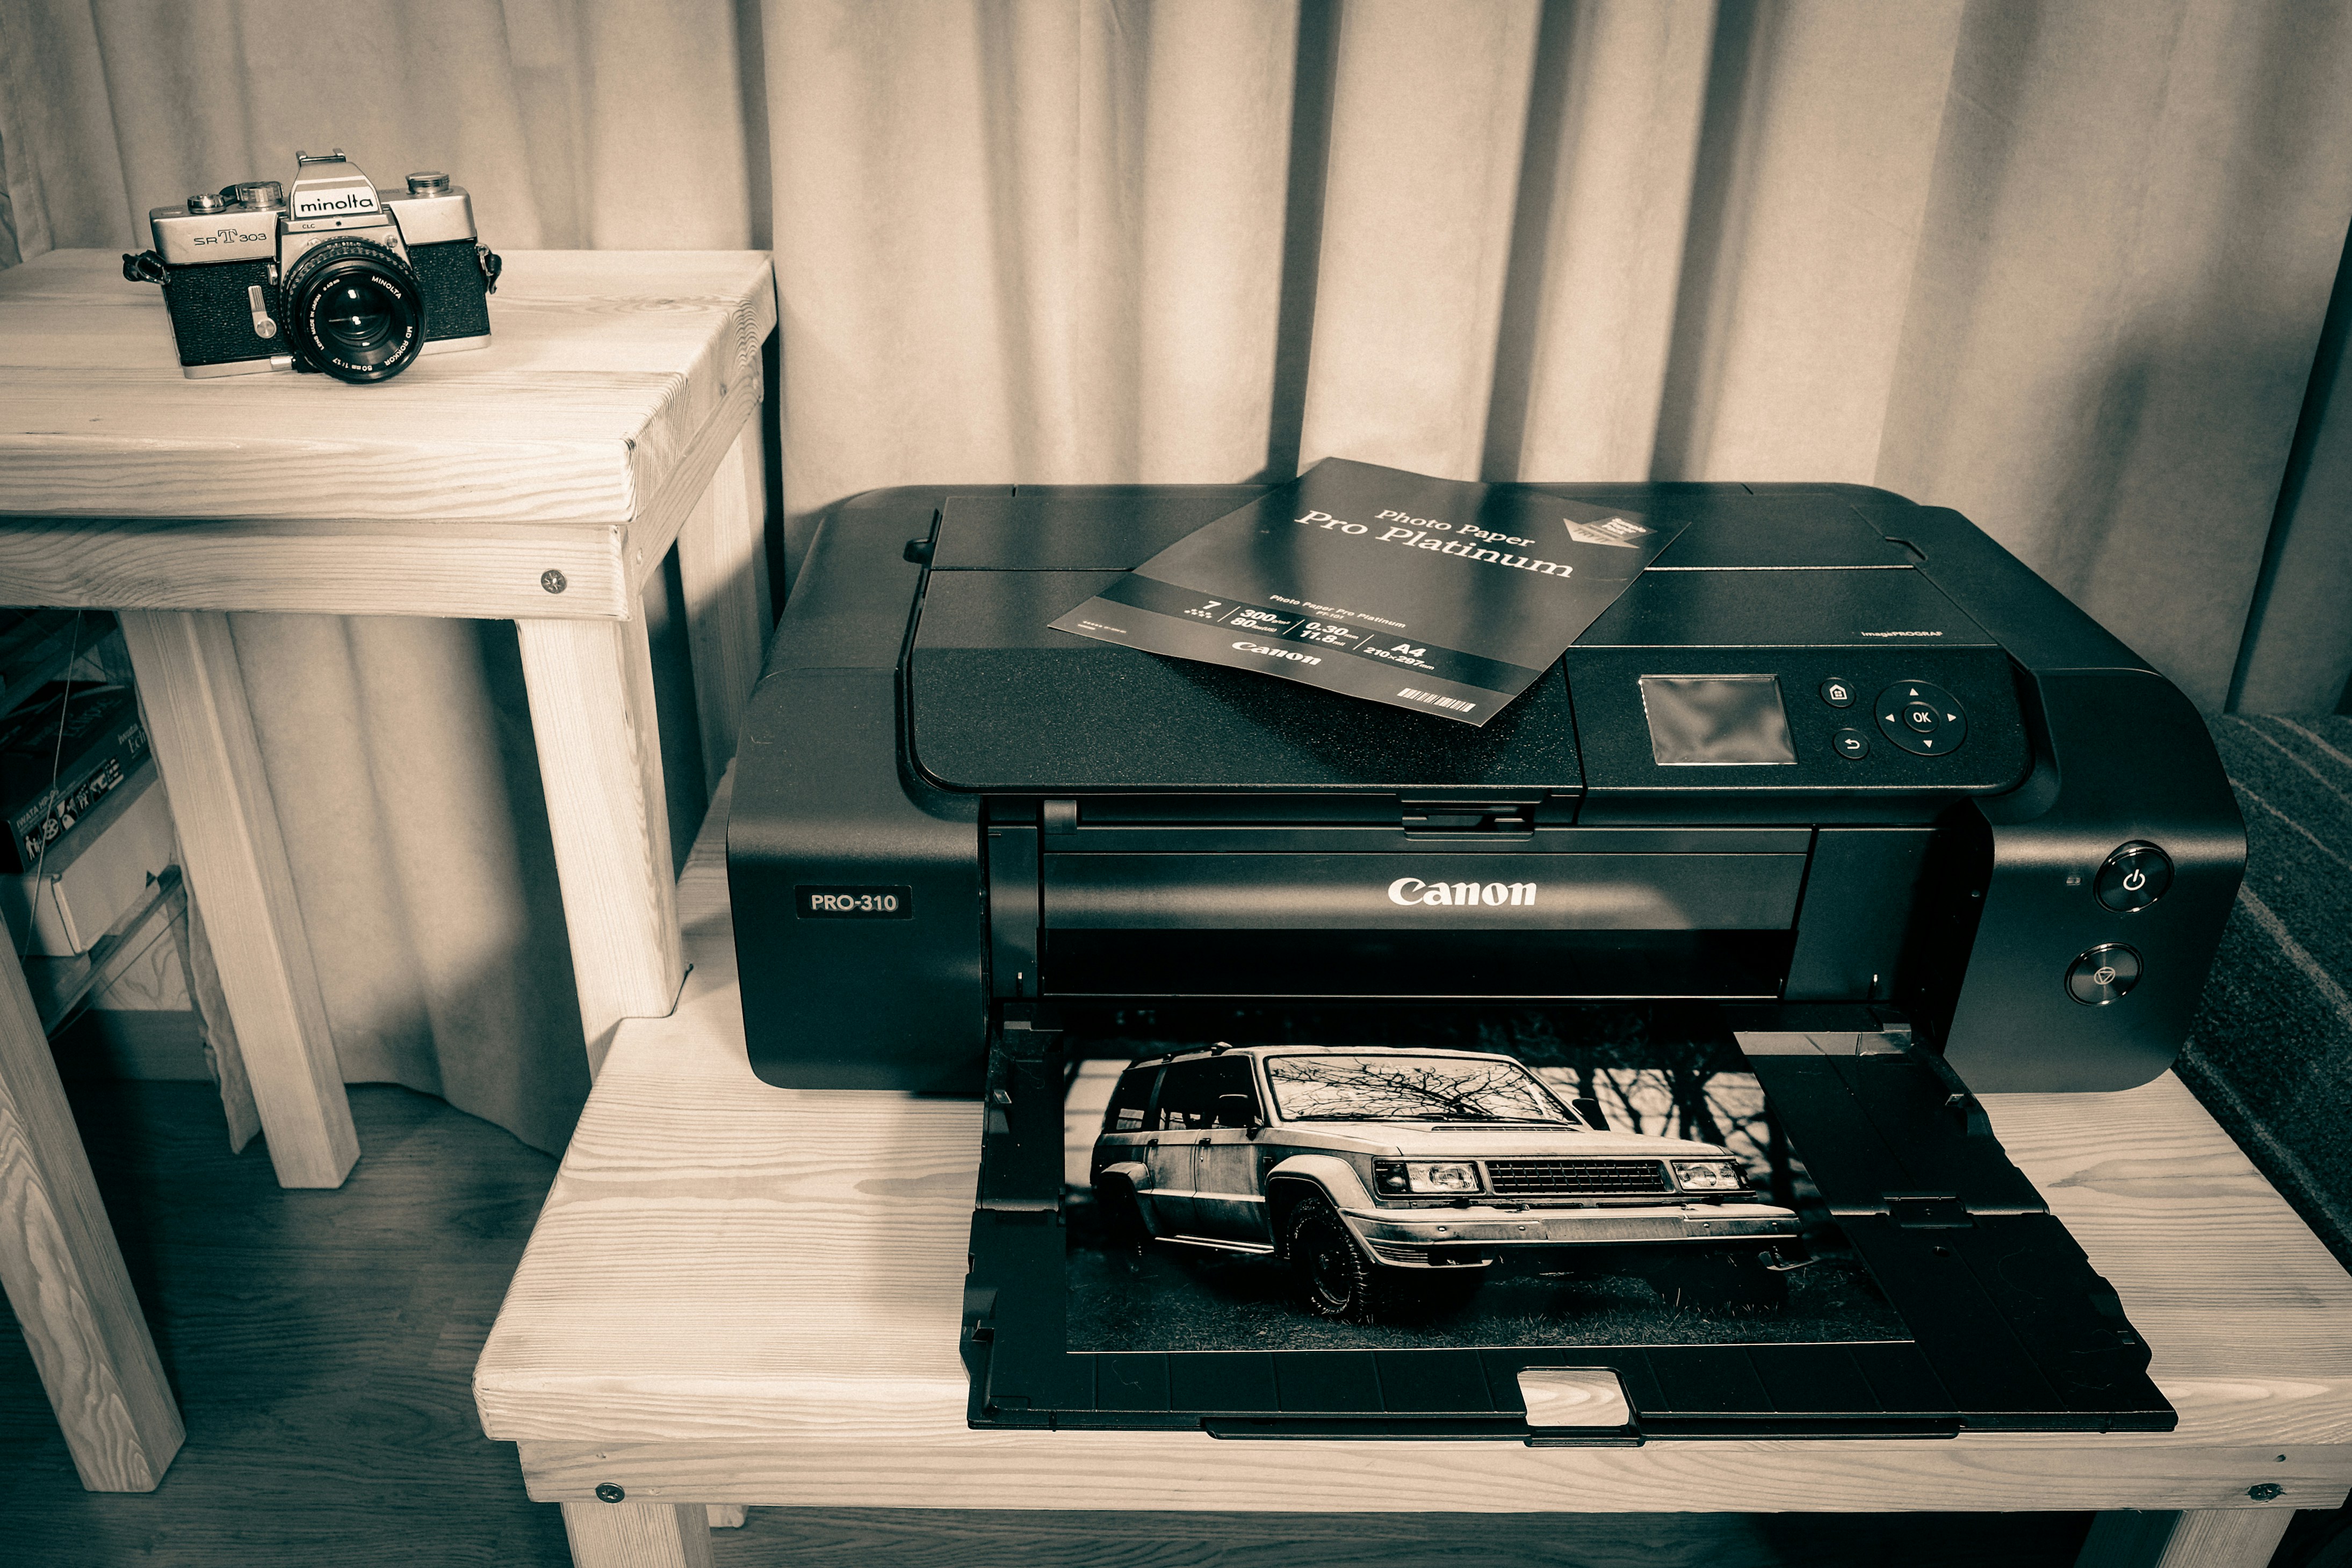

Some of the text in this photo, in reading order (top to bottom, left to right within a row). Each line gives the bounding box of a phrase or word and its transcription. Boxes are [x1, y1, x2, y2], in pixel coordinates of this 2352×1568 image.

[300, 194, 373, 212] minolta
[371, 275, 402, 299] MINOLTA
[314, 335, 325, 351] LENS
[405, 326, 413, 339] MD
[384, 339, 409, 366] ROKKOR
[1374, 509, 1535, 547] Photo Paper
[1294, 510, 1574, 578] Pro Platinum
[1202, 600, 1222, 610] 7
[1269, 594, 1406, 628] Photo Paper Pro Platinum
[1316, 610, 1345, 619] PT-101
[1231, 641, 1322, 666] Canon
[1390, 643, 1427, 657] A4
[1913, 712, 1932, 723] OK
[16, 805, 39, 829] IWATA
[1388, 877, 1537, 906] Canon
[811, 894, 897, 911] PRO-310
